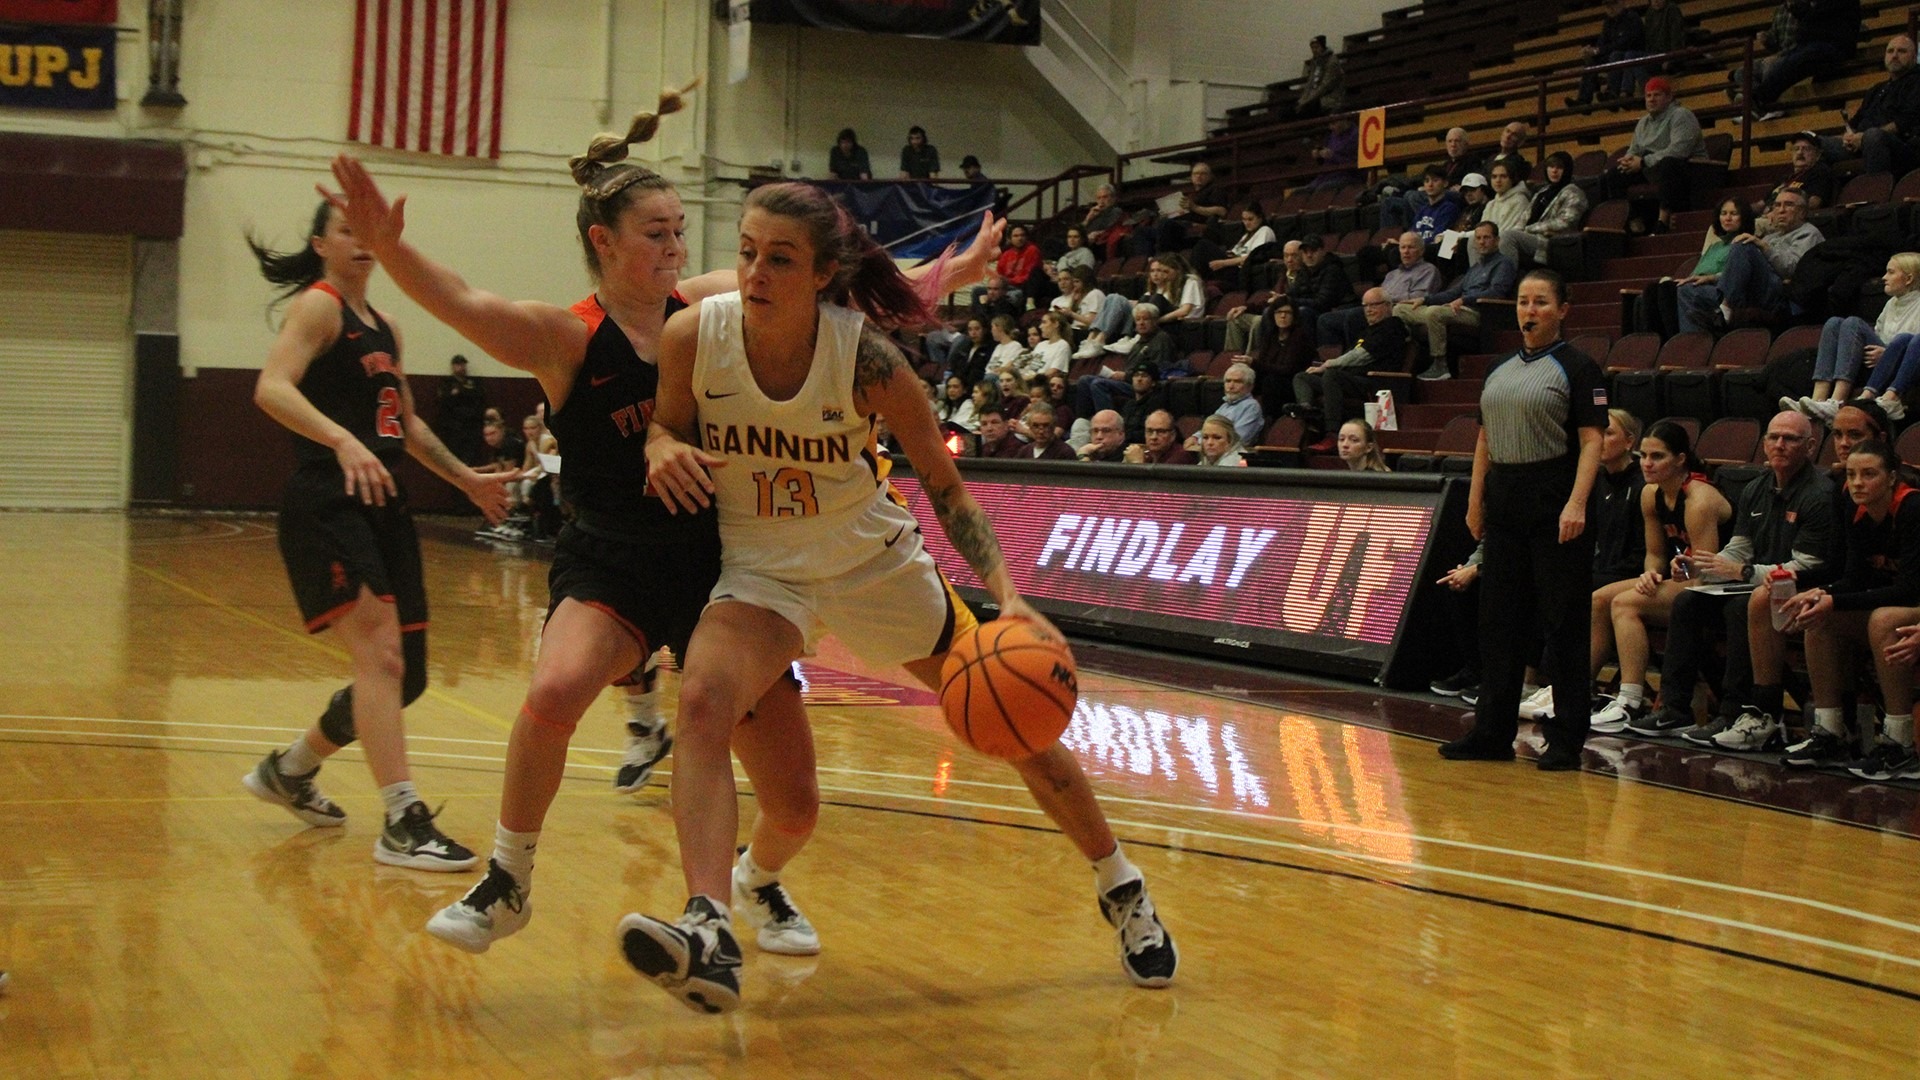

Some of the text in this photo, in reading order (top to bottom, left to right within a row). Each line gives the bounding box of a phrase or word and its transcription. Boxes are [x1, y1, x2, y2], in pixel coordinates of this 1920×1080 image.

[0, 44, 102, 88] UPJ
[1362, 115, 1381, 160] C
[376, 386, 404, 438] 2
[706, 423, 850, 463] GANNON
[752, 467, 819, 517] 13
[1037, 513, 1277, 588] FINDLAY
[1282, 502, 1425, 639] UF
